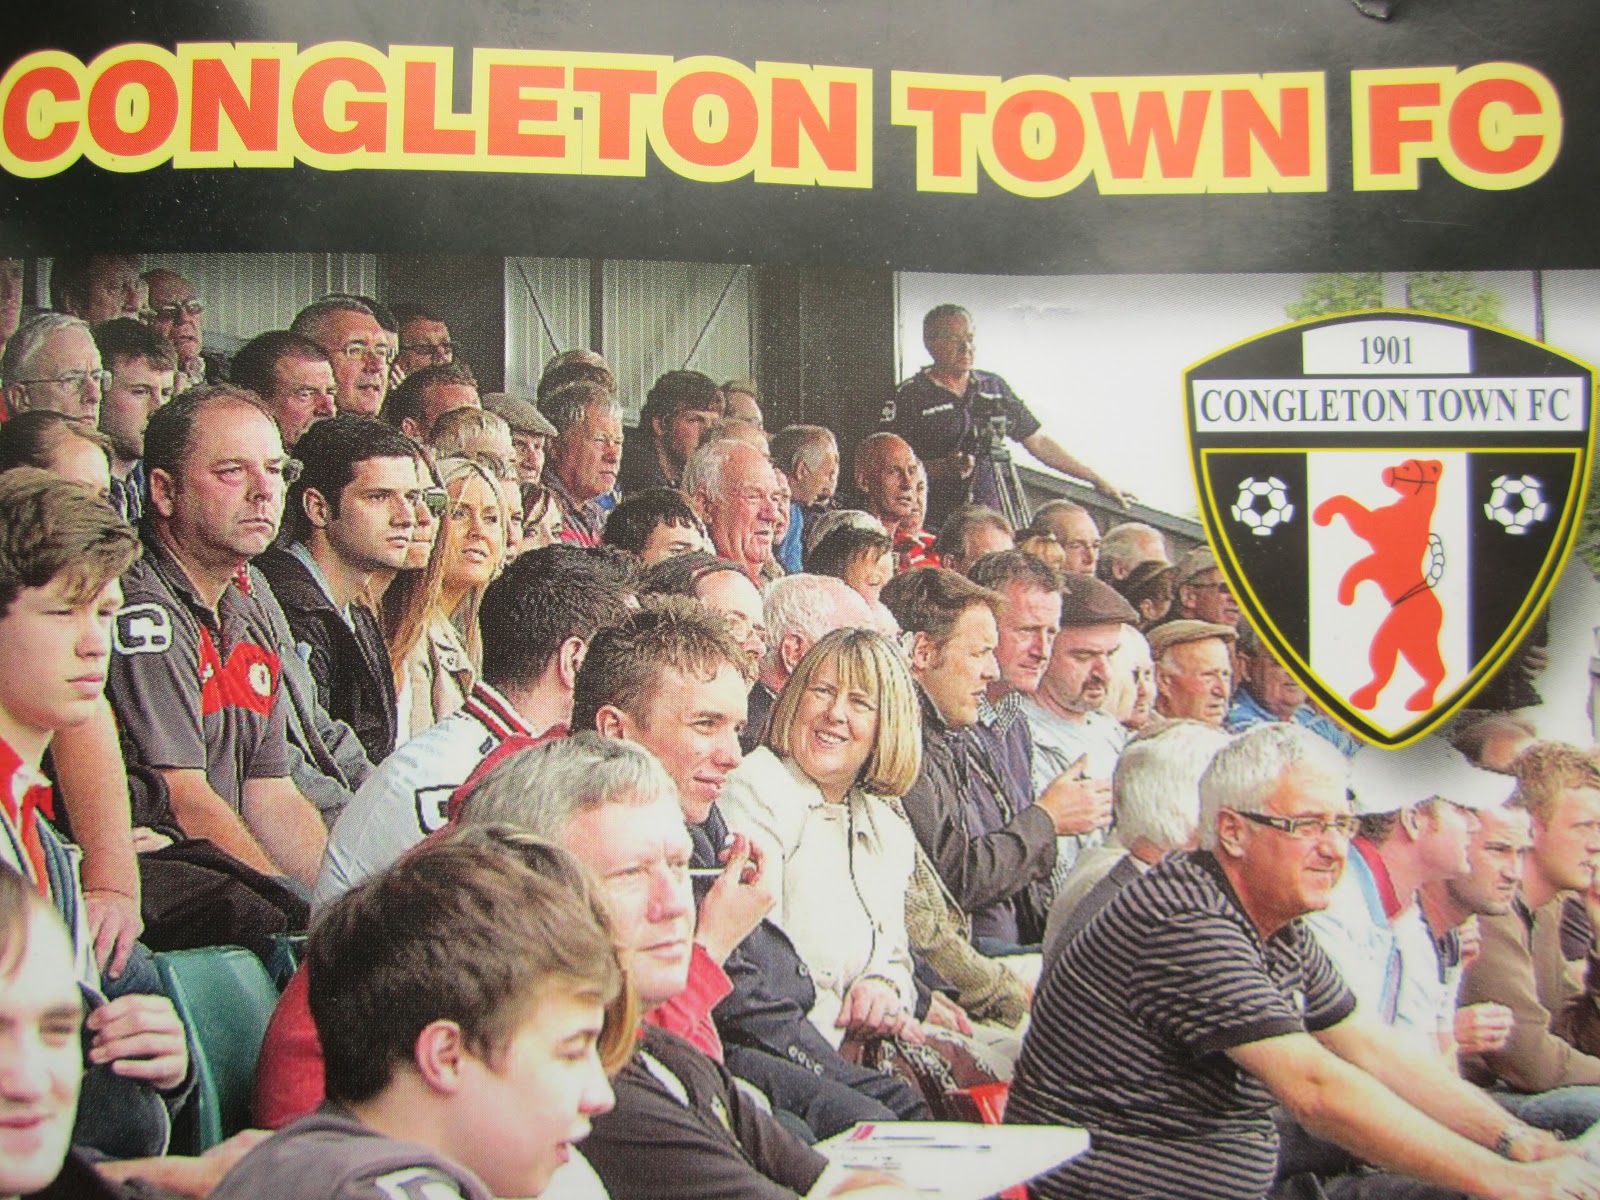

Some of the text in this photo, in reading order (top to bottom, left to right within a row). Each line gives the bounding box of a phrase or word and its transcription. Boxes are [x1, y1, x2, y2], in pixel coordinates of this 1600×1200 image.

[0, 52, 1550, 188] CONGLETON TOWN FC
[1360, 336, 1414, 365] 1901
[1200, 388, 1571, 423] CONGLETON TOWN FC
